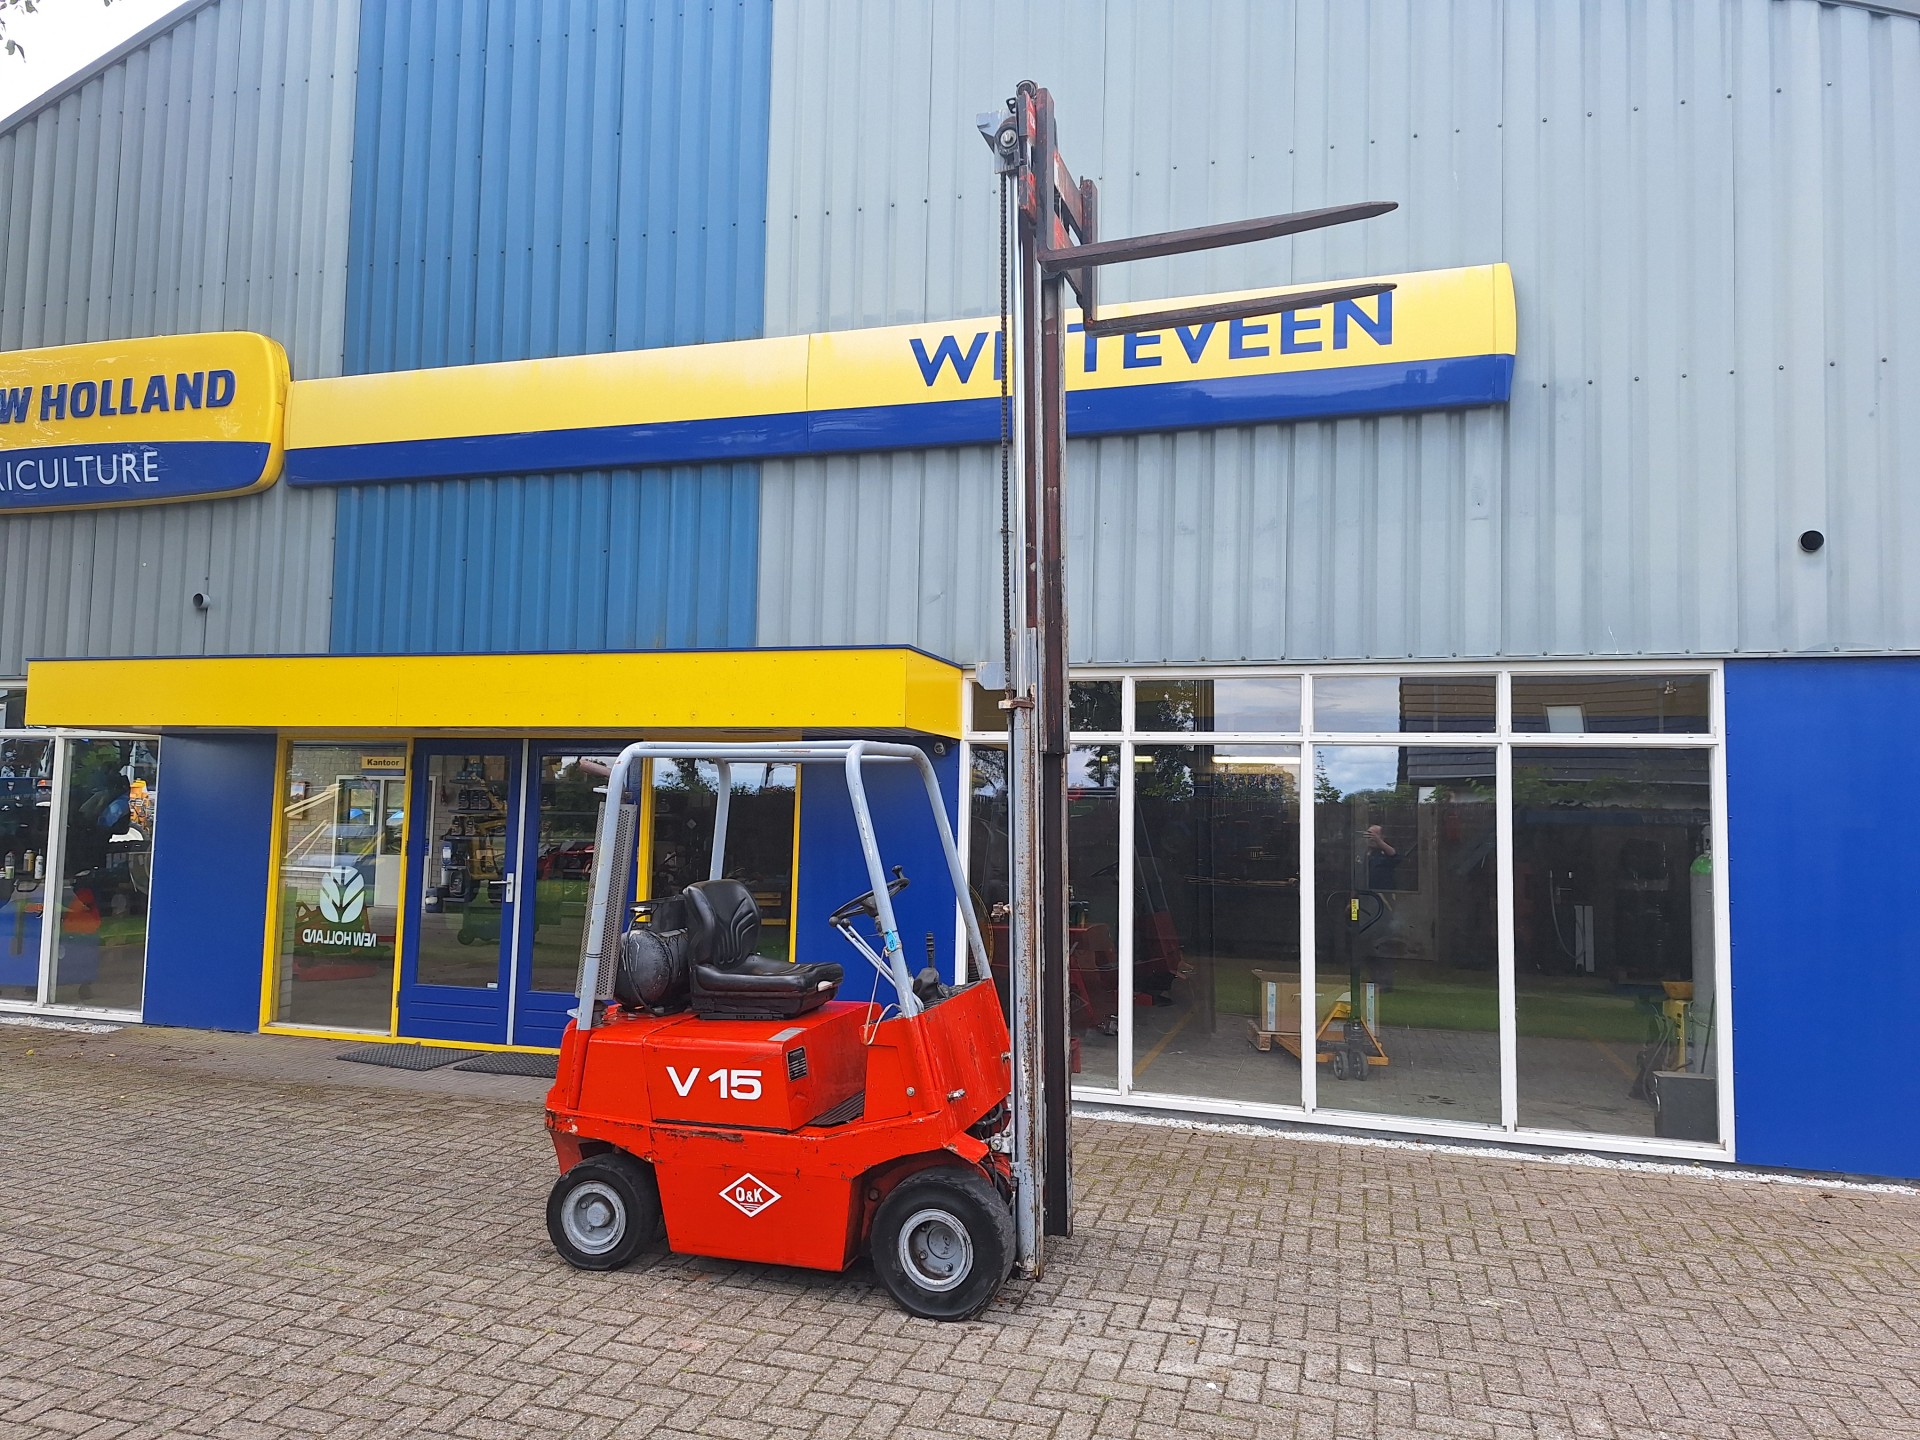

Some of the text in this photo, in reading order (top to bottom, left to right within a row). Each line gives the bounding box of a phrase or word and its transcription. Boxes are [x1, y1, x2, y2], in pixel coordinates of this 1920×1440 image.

[909, 291, 1393, 387] WITEVEEN
[40, 369, 236, 421] HOLLAND
[0, 451, 159, 492] ICULTURE
[367, 758, 400, 767] Kantoor
[666, 1066, 762, 1100] V 15
[735, 1186, 764, 1203] O&K
